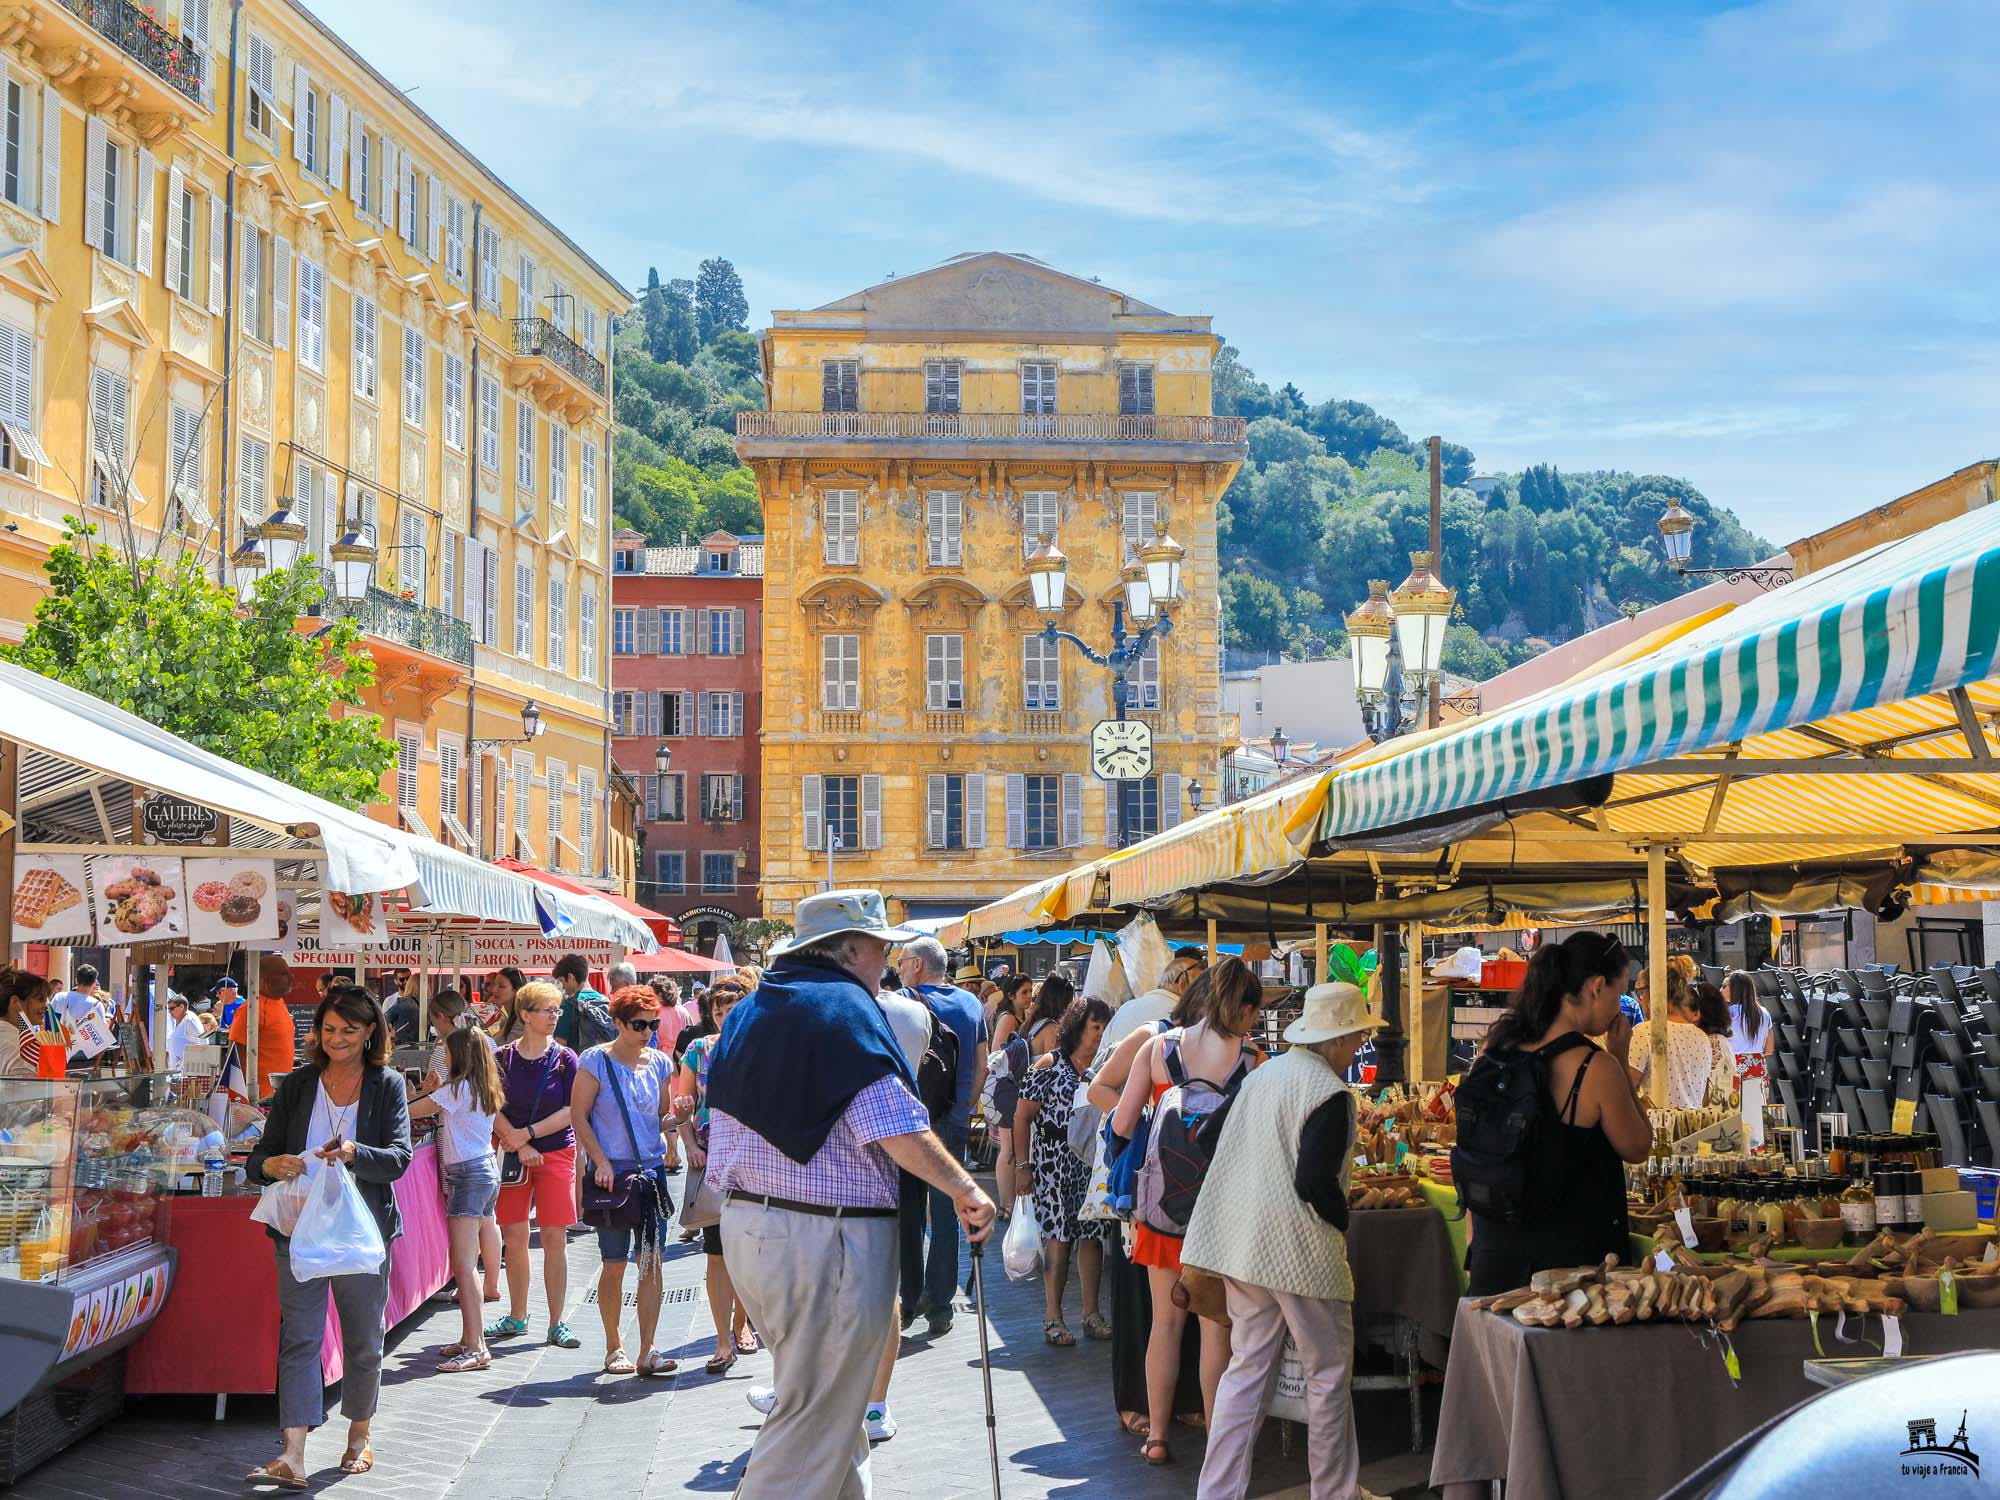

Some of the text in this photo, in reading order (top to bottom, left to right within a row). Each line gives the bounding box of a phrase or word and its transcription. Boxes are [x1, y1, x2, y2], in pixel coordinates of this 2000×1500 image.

[148, 805, 213, 821] GAUFRES
[678, 907, 706, 922] FASHION
[474, 938, 515, 950] SOCCA
[527, 938, 613, 950] PISSALADIERE
[293, 952, 371, 964] SPECIALITS
[474, 954, 519, 965] FARCIS
[532, 954, 557, 965] PAN
[85, 1023, 102, 1047] FRANCE
